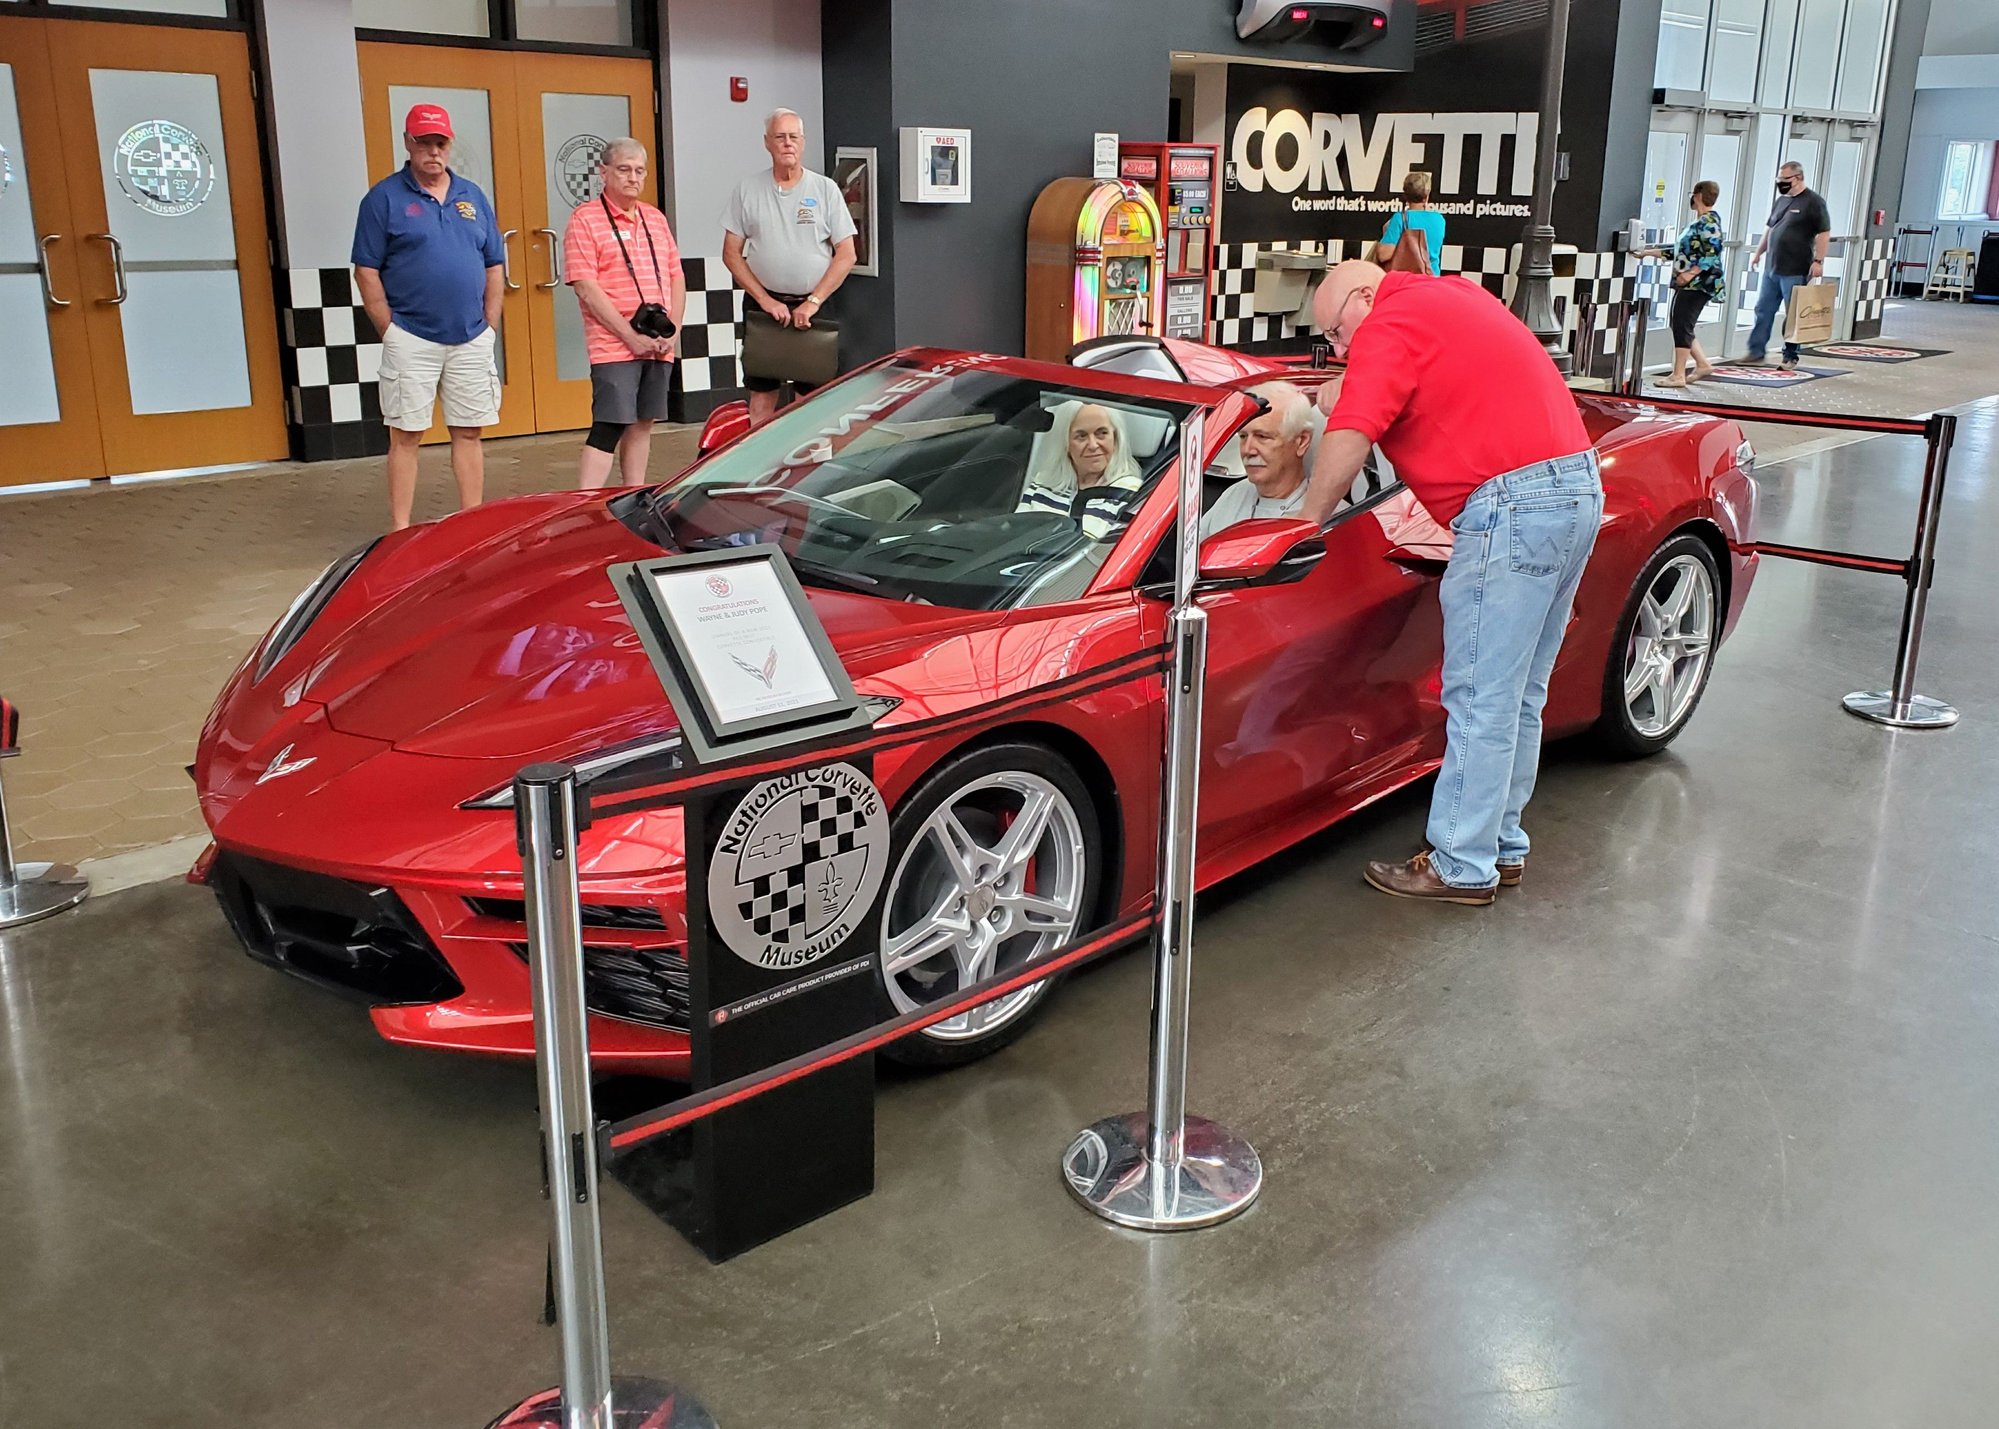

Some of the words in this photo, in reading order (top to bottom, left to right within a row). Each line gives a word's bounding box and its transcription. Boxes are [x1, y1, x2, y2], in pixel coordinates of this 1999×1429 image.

[941, 137, 954, 145] AED
[1292, 196, 1312, 212] One
[1313, 195, 1336, 211] word
[1336, 195, 1366, 212] that's
[1367, 197, 1403, 213] worth
[1475, 200, 1531, 218] pictures.
[697, 613, 724, 623] WAYNE
[724, 611, 731, 619] &
[731, 609, 748, 618] JUDY
[749, 606, 768, 615] POPE
[698, 598, 760, 613] CONGRATULATIONS
[719, 768, 800, 856] National
[805, 768, 878, 817] Corvette
[759, 922, 851, 966] Museum
[732, 1005, 743, 1014] THE
[743, 996, 769, 1010] OFFICIAL
[769, 991, 781, 1000] CAR
[782, 985, 798, 996] CARE
[797, 975, 824, 990] PRODUCT
[824, 965, 852, 980] PROVIDER
[852, 962, 860, 970] OF
